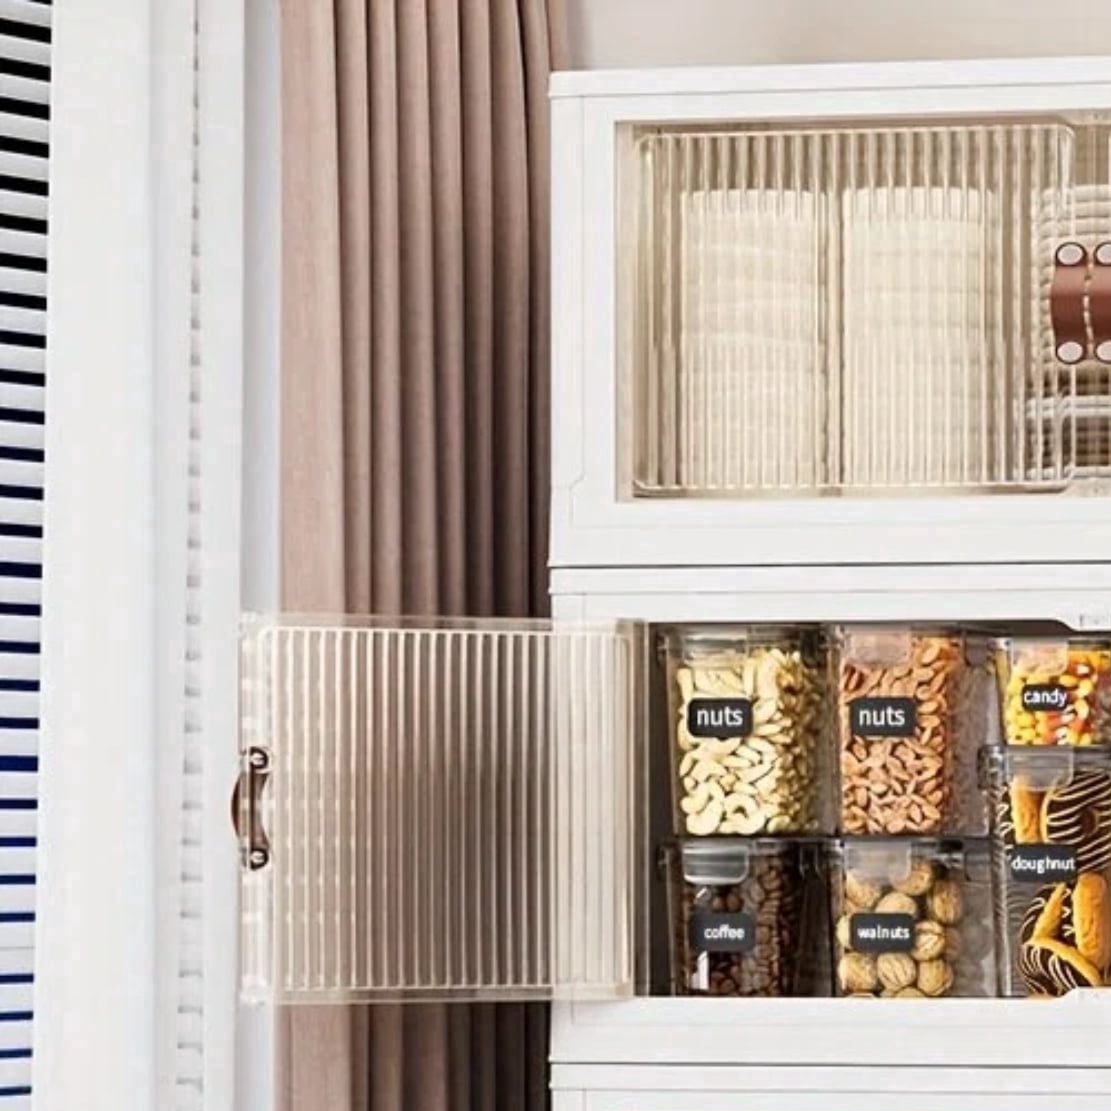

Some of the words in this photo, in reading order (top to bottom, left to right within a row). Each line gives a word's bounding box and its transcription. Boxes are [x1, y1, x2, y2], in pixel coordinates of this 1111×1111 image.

[1024, 689, 1067, 707] candy
[697, 706, 743, 725] nuts
[859, 706, 905, 725] nuts
[1011, 855, 1075, 874] doughnut
[704, 926, 745, 940] coffee
[857, 926, 910, 940] walnuts
